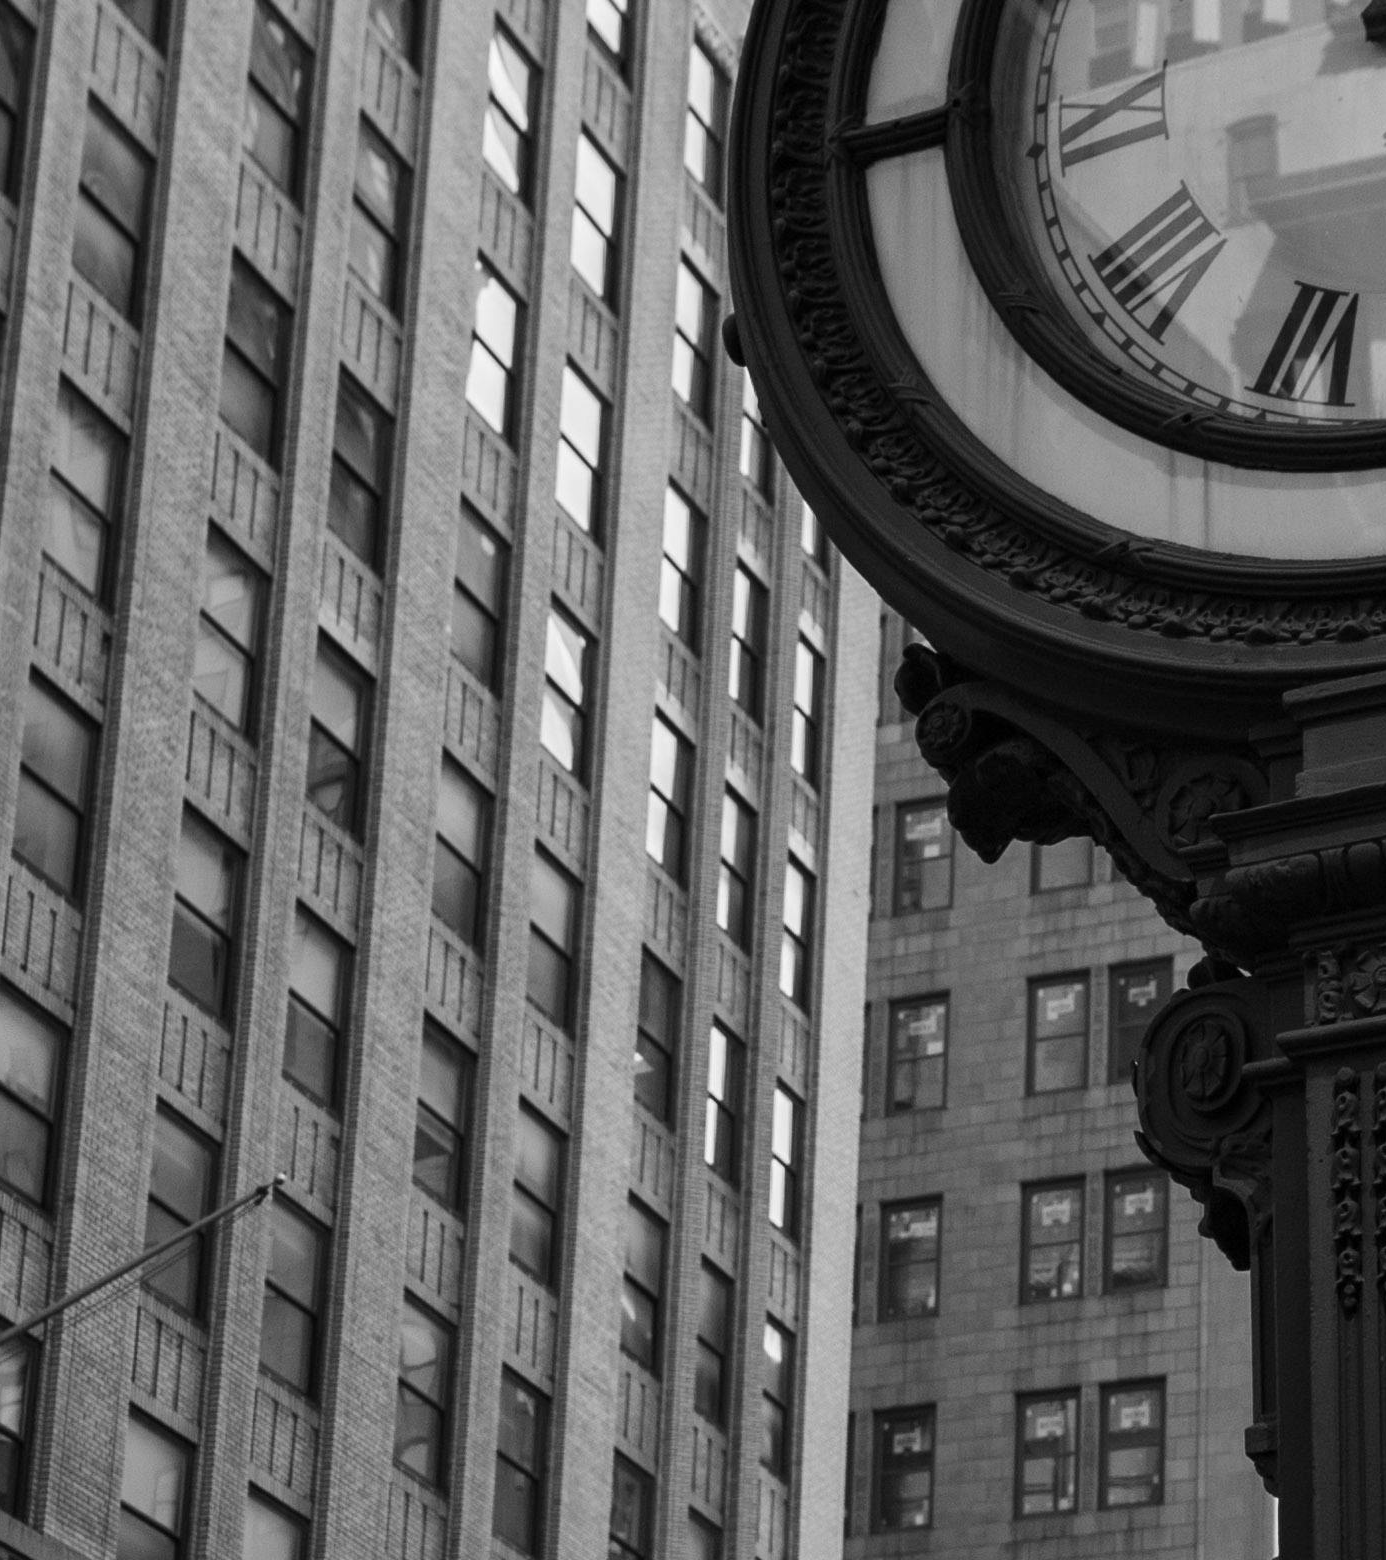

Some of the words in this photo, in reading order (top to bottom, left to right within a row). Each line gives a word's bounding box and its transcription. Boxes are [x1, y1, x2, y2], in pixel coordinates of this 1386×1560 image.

[1058, 61, 1169, 178] IX
[1088, 181, 1227, 347] VIII
[1248, 280, 1360, 408] VII
